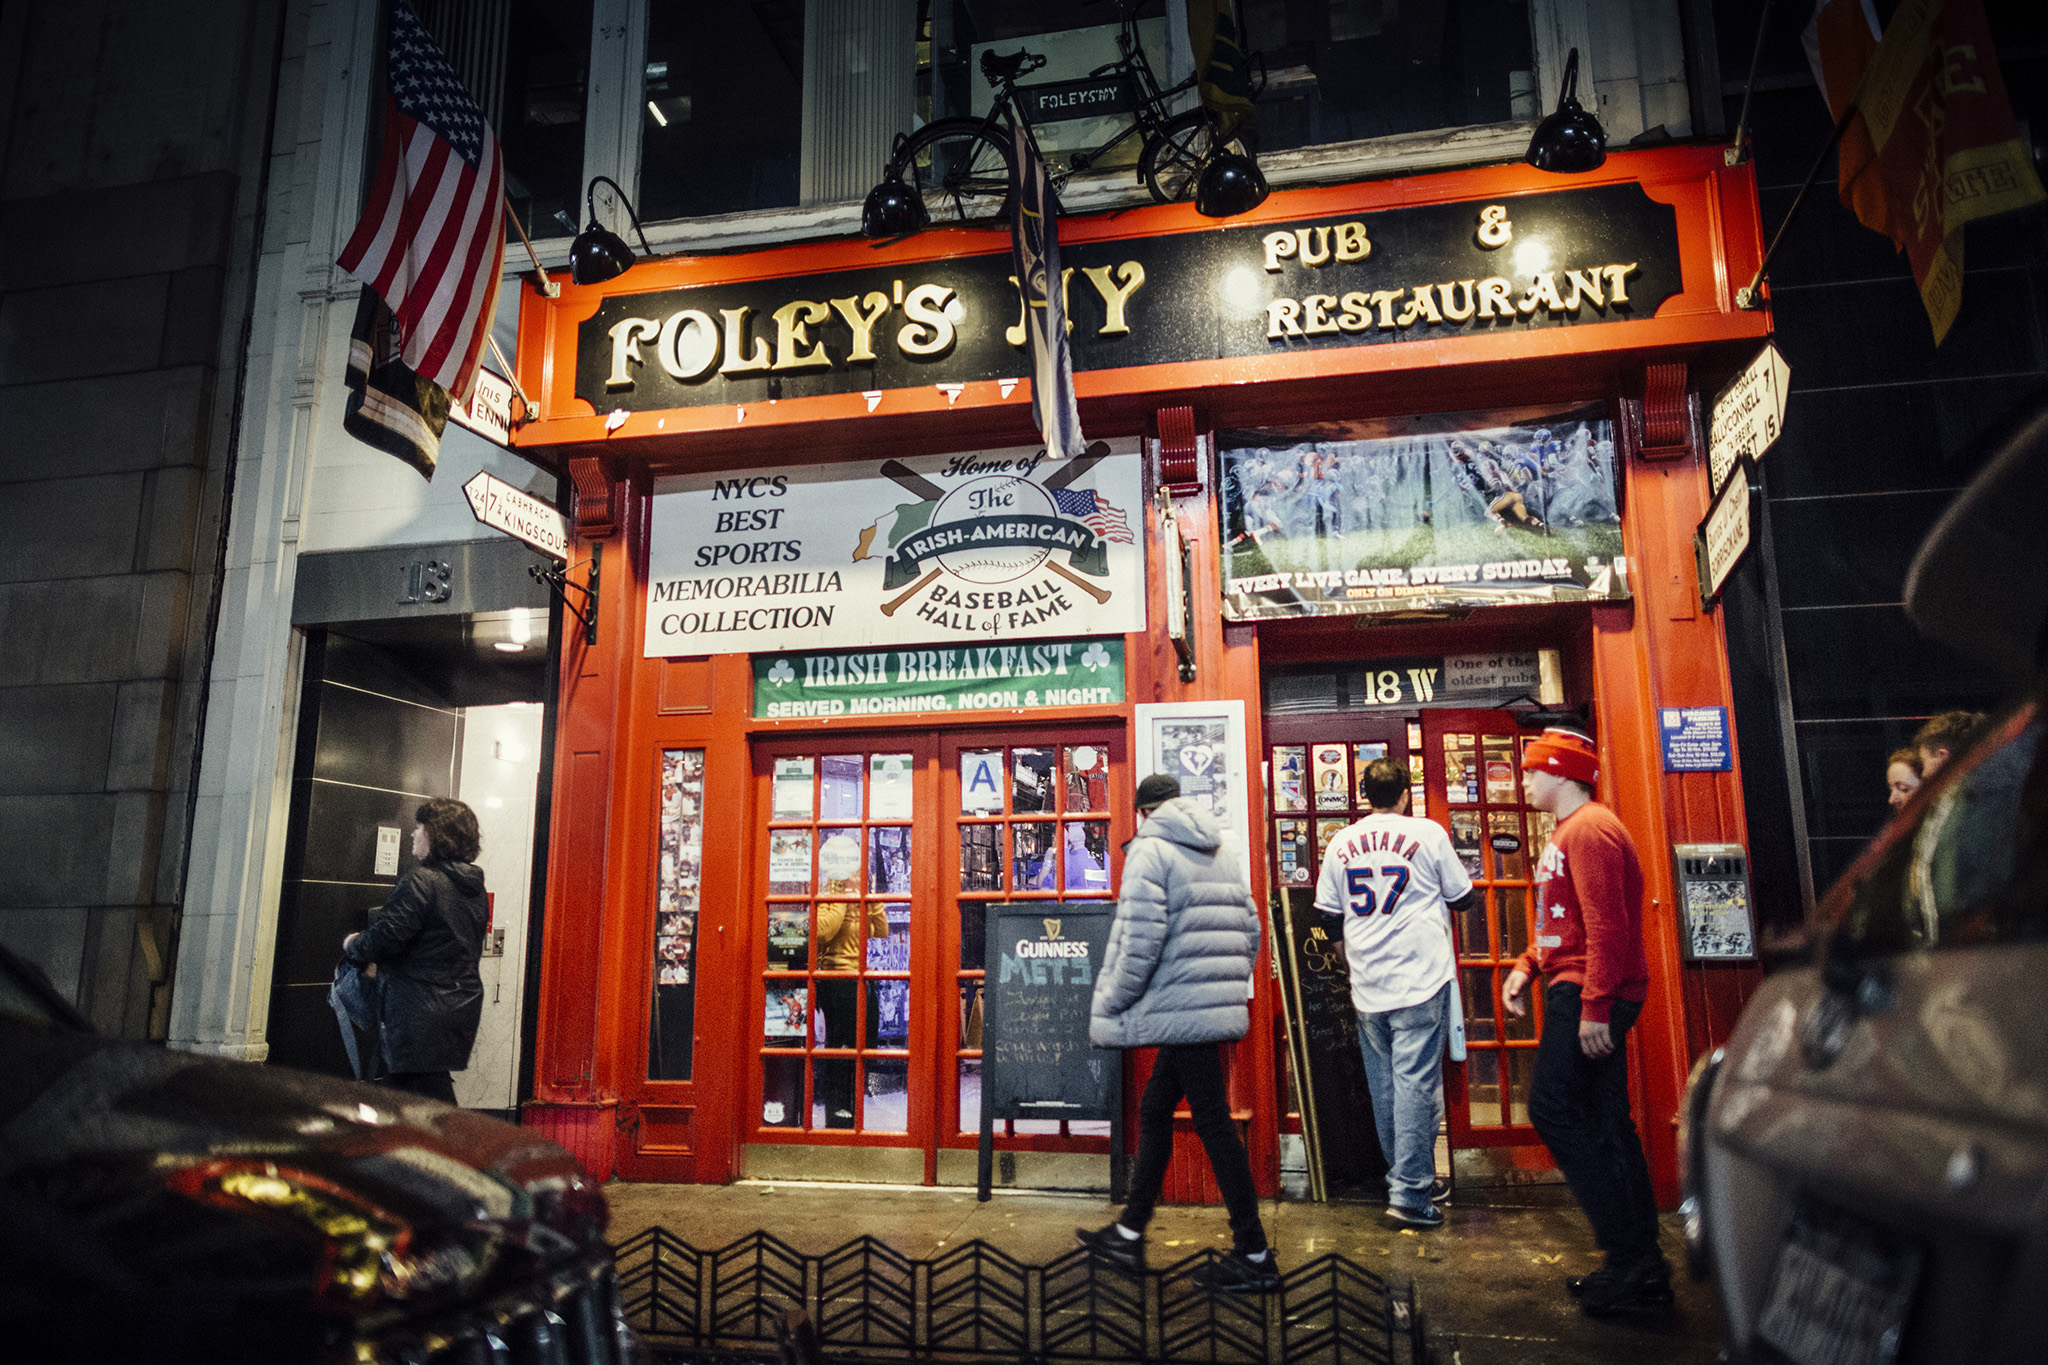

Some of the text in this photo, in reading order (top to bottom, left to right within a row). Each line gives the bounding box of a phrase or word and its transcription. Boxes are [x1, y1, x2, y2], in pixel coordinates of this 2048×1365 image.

[1262, 205, 1513, 274] PUB &
[1266, 261, 1638, 341] RESTAURANT
[606, 279, 957, 387] FOLEY'S
[940, 449, 1048, 479] Home of
[711, 475, 788, 501] NYC'S
[968, 488, 1015, 511] The
[714, 508, 785, 533] BEST
[694, 539, 802, 568] SPORTS
[904, 523, 1087, 560] IRISH-AMERICAN
[652, 570, 843, 603] MEMORABILIA
[1227, 573, 1293, 595] EVERY
[1295, 570, 1342, 588] LIVE
[1344, 568, 1409, 587] GAME.
[1411, 564, 1480, 585] EVERY
[1482, 558, 1572, 581] SUNDAY.
[928, 579, 1062, 610] BASEBALL
[1346, 588, 1374, 600] ONLY
[660, 605, 836, 636] COLLECTION
[916, 594, 1073, 635] HALL of FAME
[802, 643, 1072, 688] IRISH BREAKFAST
[1450, 672, 1538, 687] oldest pubs
[1453, 655, 1533, 671] One of the
[766, 687, 1112, 719] SERVED MORNING, NOON & NIGHT
[1364, 668, 1438, 705] 18 W
[969, 760, 997, 793] A
[1336, 831, 1421, 865] SANTANA
[1346, 865, 1410, 917] 57
[1015, 939, 1089, 958] GUINNESS
[998, 951, 1092, 986] METS
